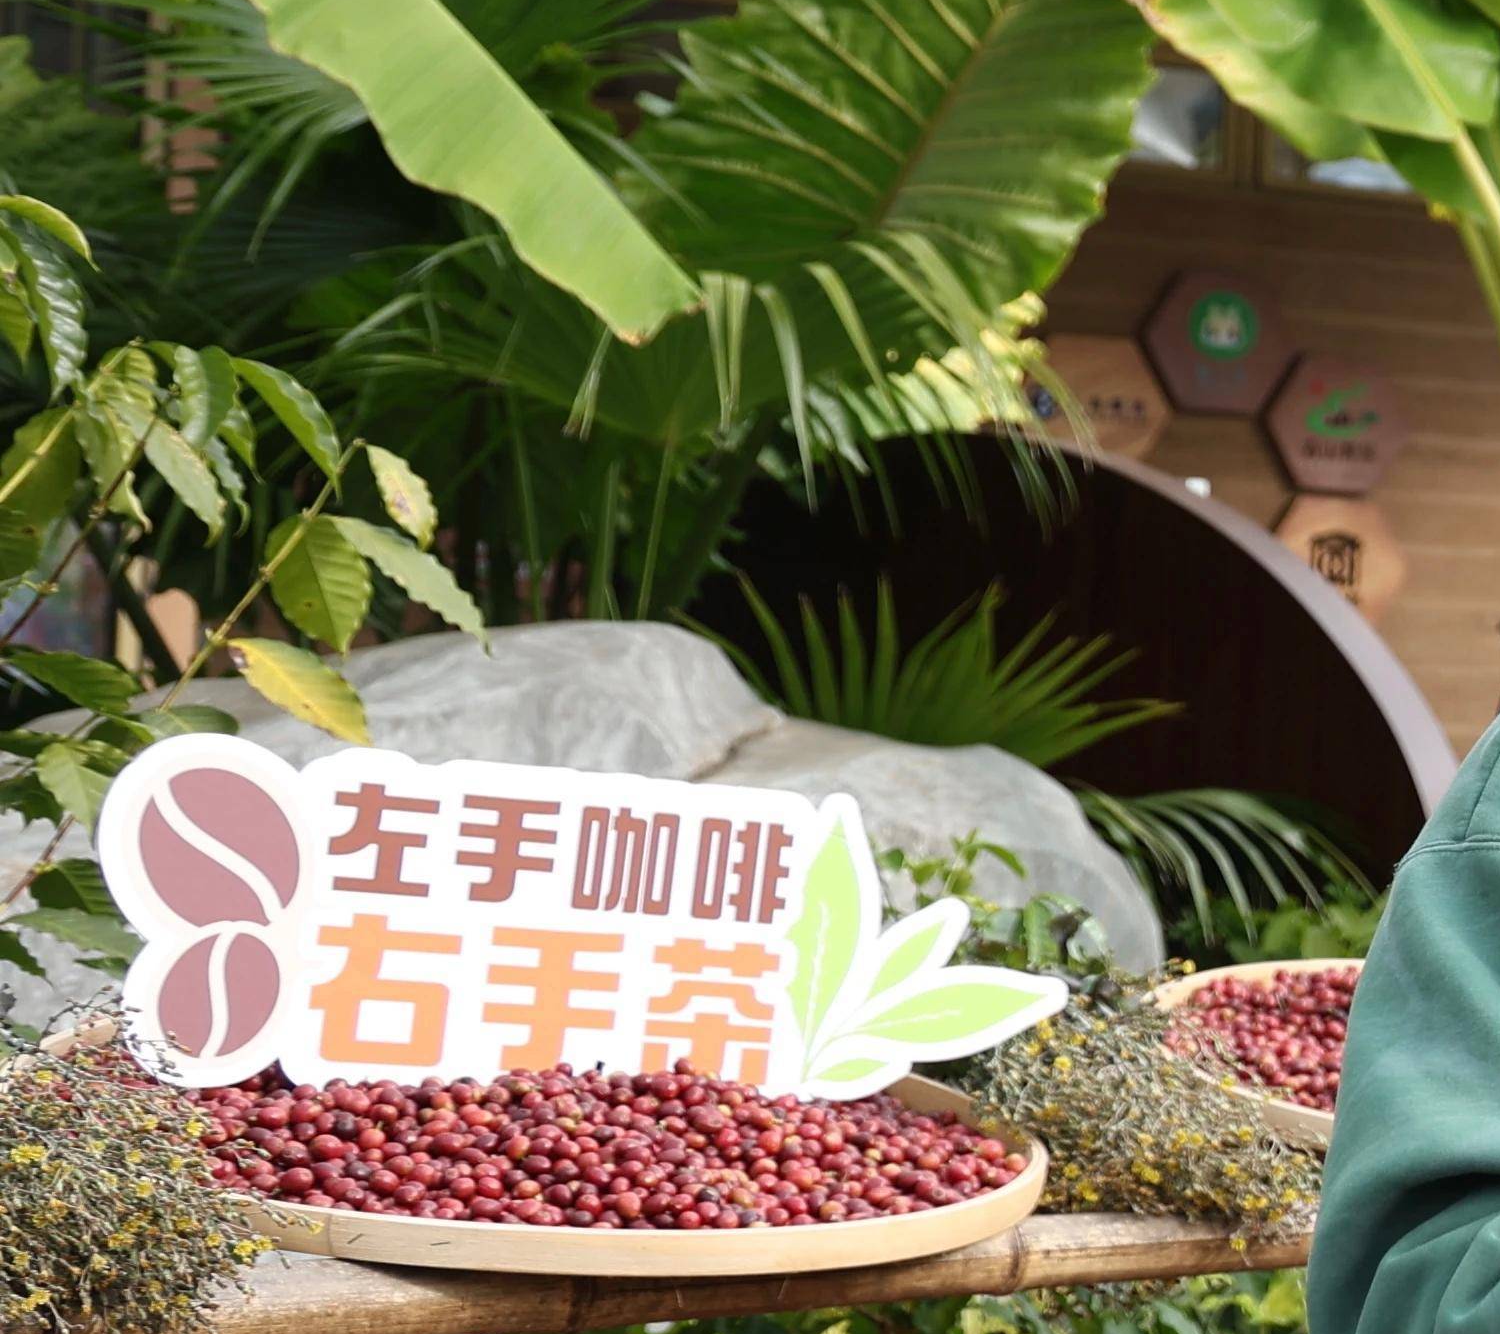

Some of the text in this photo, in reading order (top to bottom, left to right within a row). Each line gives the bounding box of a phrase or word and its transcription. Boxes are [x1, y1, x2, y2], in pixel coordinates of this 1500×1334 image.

[327, 782, 793, 924] 左手咖啡
[309, 913, 780, 1086] 右手茶
